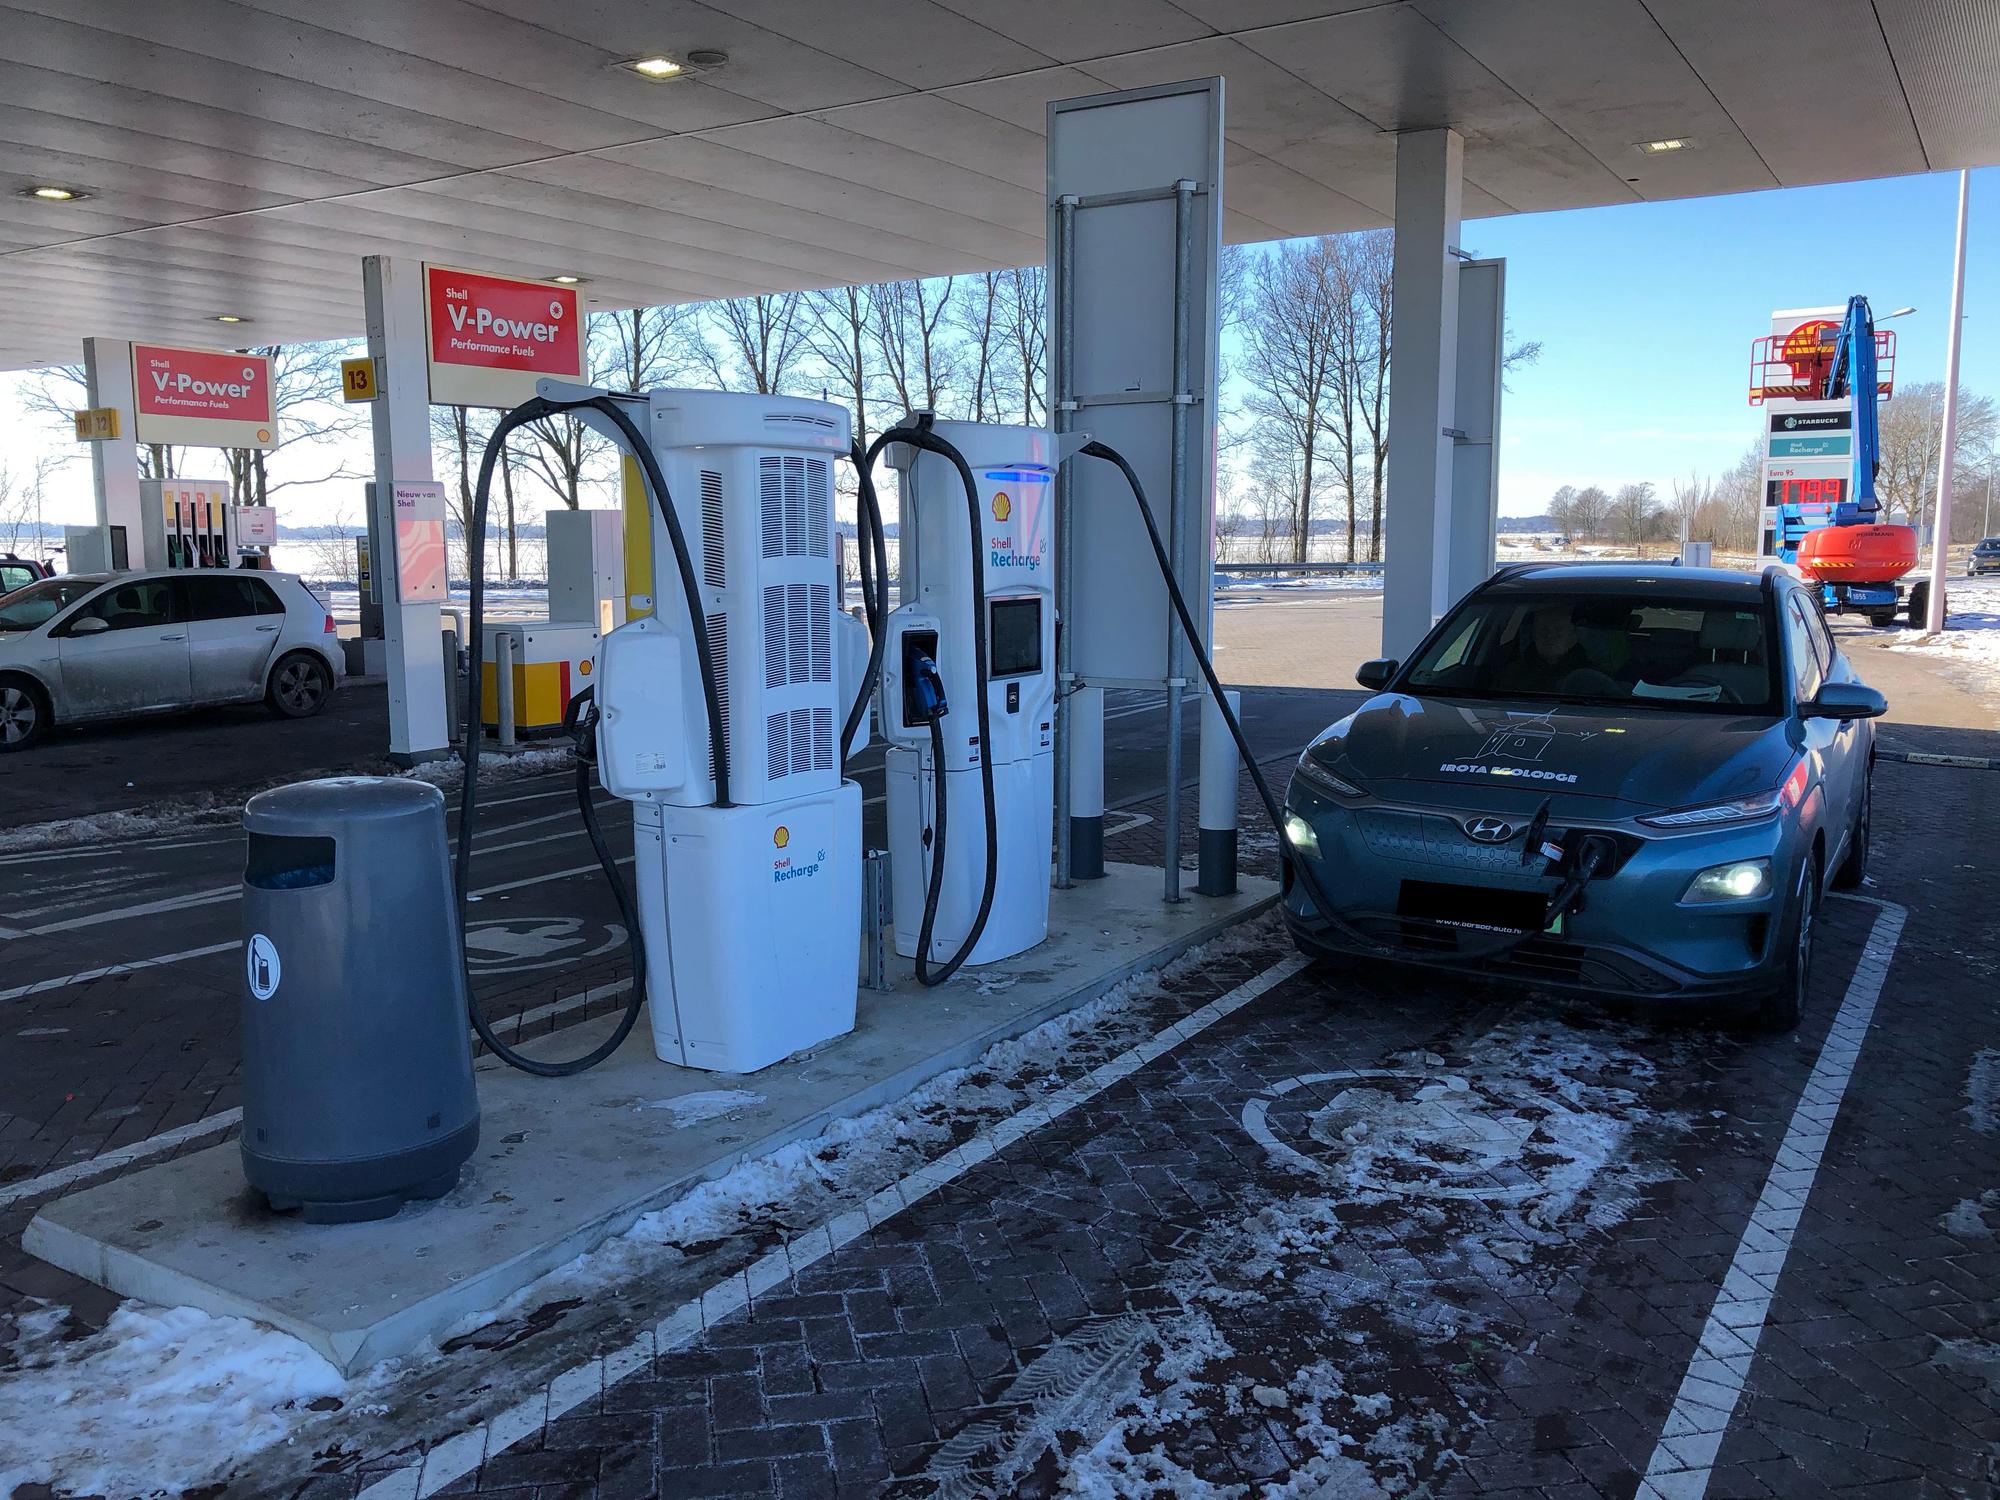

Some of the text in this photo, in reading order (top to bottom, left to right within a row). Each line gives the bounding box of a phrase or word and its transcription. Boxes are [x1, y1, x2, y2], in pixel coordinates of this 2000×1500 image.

[446, 287, 468, 300] Shell
[447, 303, 559, 343] V-Power
[450, 337, 535, 357] Performance Fuels
[150, 359, 170, 368] Shell
[151, 371, 251, 398] V-Power
[348, 369, 368, 390] 13
[155, 395, 230, 409] Performance Fuels
[96, 415, 107, 431] 12
[1797, 417, 1839, 425] STARBUCKS
[1789, 446, 1823, 454] Recharge
[1769, 469, 1794, 477] Euro 95
[396, 490, 421, 498] Nieuw
[397, 499, 416, 508] Shell
[991, 537, 1012, 549] Shell
[991, 550, 1041, 570] Recharge
[1440, 763, 1578, 783] IROTA ECOLODGE
[774, 857, 791, 870] Shell
[774, 863, 819, 883] Recharge
